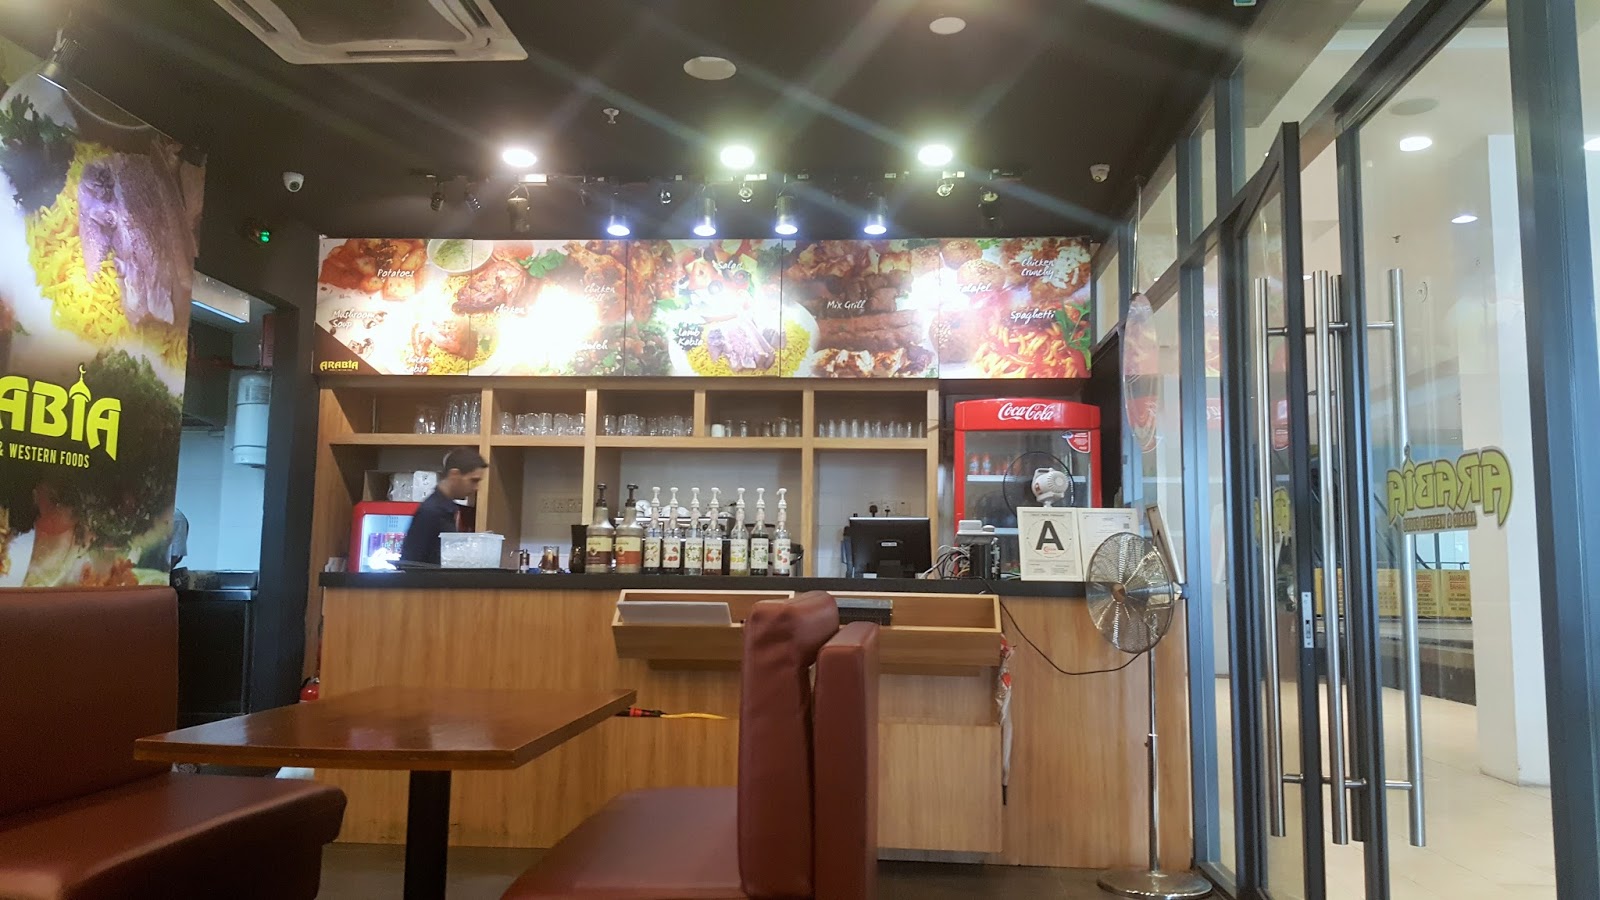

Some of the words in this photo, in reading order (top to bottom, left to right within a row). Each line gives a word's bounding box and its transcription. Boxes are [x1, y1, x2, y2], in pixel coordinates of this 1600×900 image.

[1021, 258, 1055, 267] Chicken
[377, 268, 415, 278] Potatoes
[1021, 267, 1055, 279] Crunchy
[584, 282, 616, 294] Chicken
[826, 300, 843, 309] Mix
[844, 299, 867, 310] Grill
[333, 308, 376, 320] Mushroom
[1010, 309, 1056, 324] Spaghetti
[333, 319, 353, 329] Soup
[319, 360, 359, 371] ARABIA
[0, 366, 122, 461] ABIA
[997, 402, 1056, 422] Coca-Cola
[9, 442, 57, 464] WESTERN
[60, 450, 90, 468] FOODS
[1035, 520, 1065, 551] A
